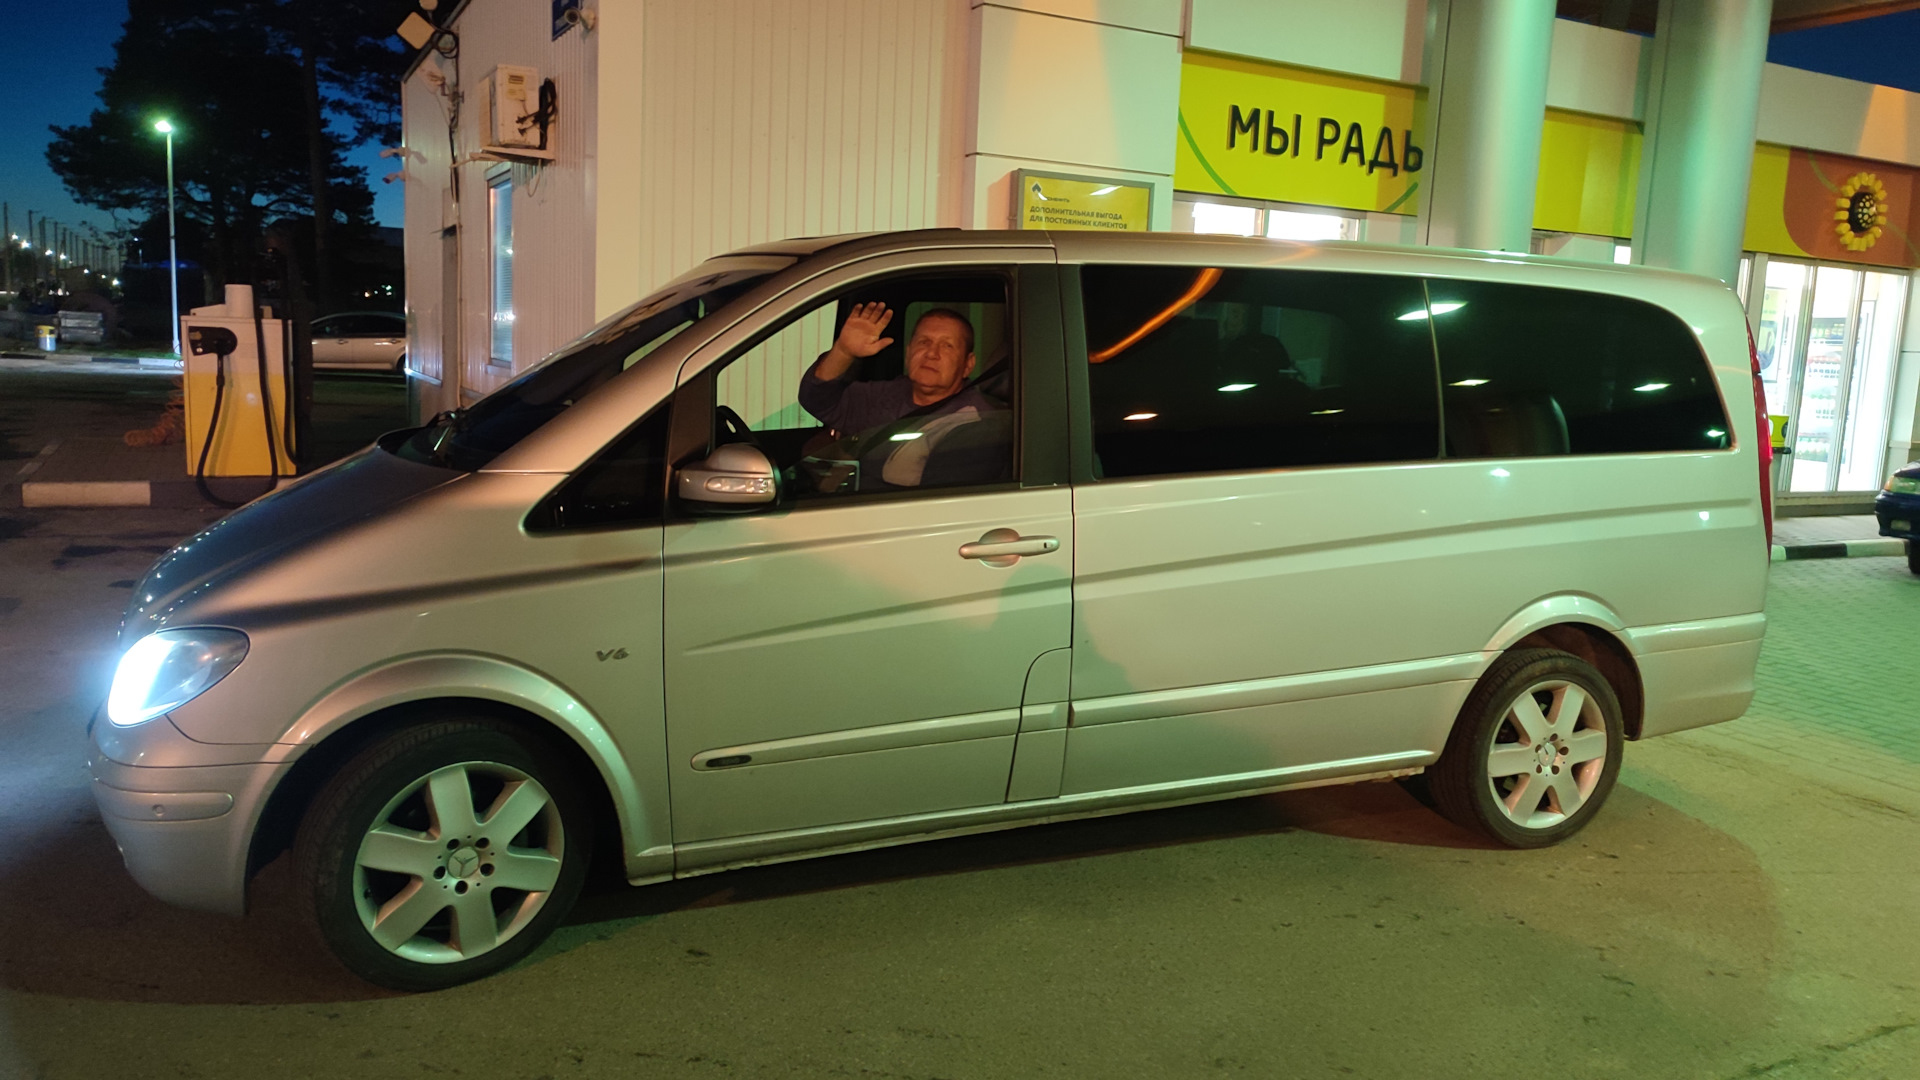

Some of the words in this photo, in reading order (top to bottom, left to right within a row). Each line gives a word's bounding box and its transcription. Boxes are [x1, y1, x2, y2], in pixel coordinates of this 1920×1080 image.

[1227, 104, 1302, 157] МЫ
[1030, 205, 1095, 217] ДОПОЛНИТЕЛЬНАЯ
[1095, 211, 1123, 220] ВЫГОДА
[1044, 216, 1092, 226] ПОСТОЯННЫХ
[1092, 220, 1128, 230] КЛИЕНТОВ
[596, 648, 630, 662] V6
